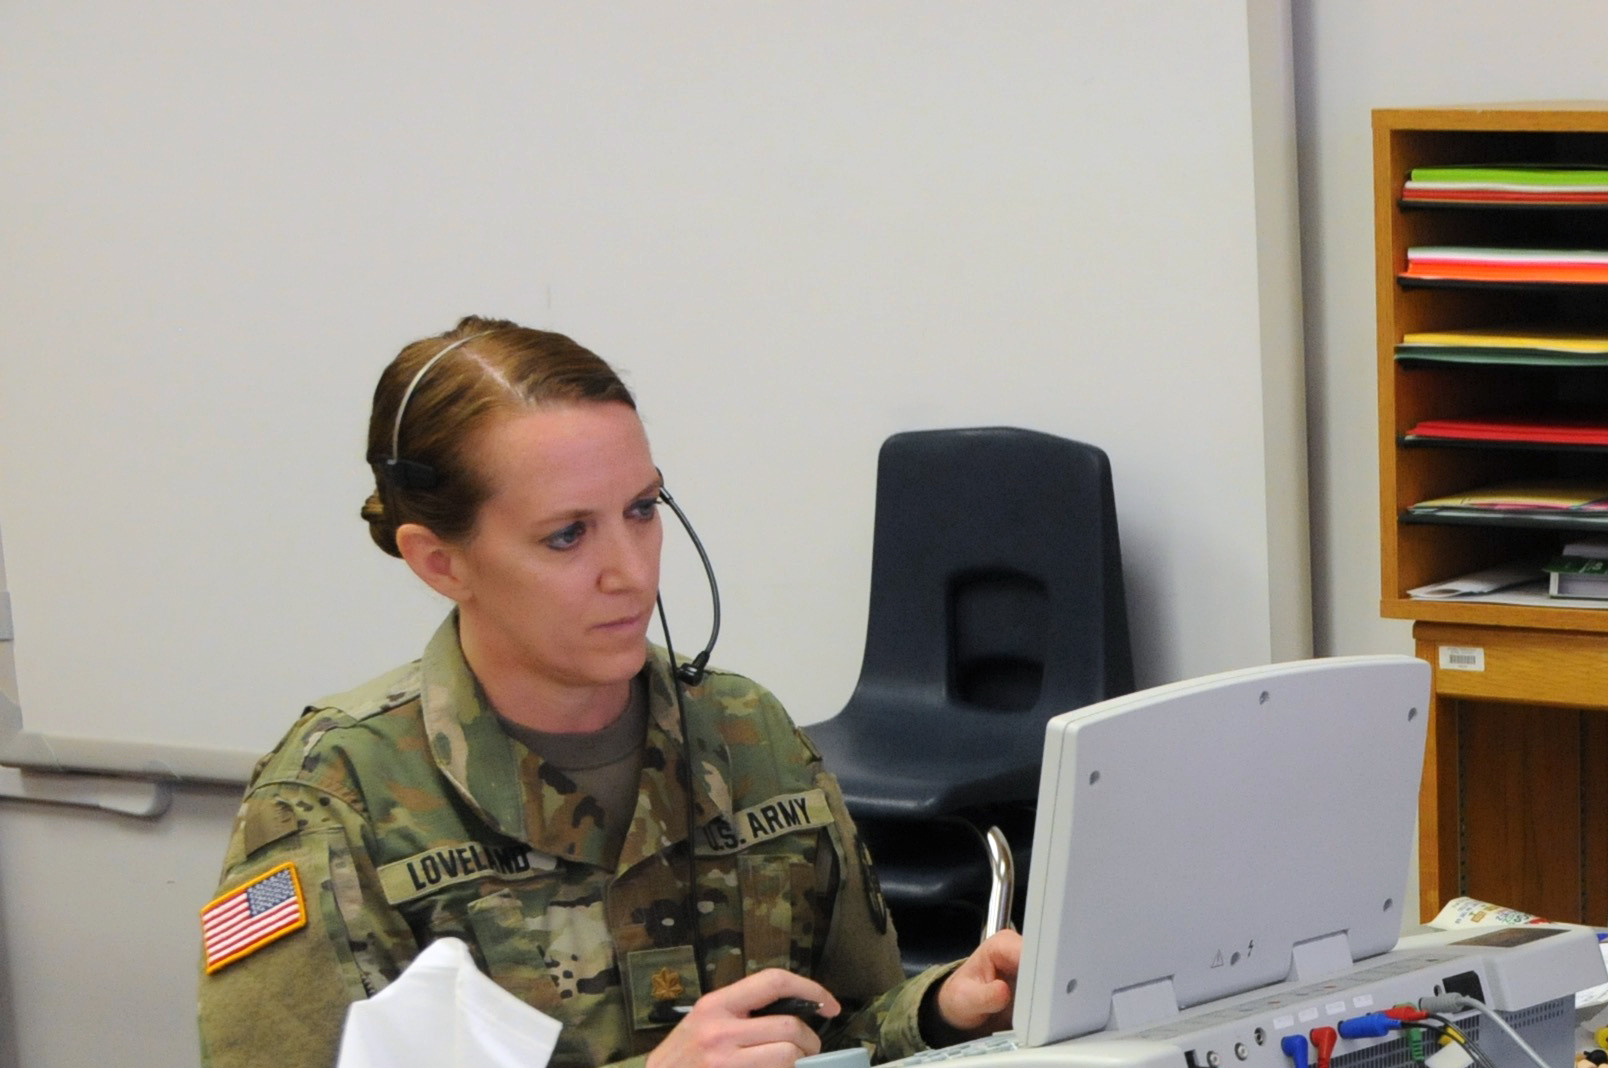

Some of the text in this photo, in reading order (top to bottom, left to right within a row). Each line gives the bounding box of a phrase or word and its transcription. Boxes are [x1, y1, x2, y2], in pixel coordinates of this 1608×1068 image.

[702, 797, 811, 851] U.S. ARMY
[406, 844, 531, 891] LOVELAND
